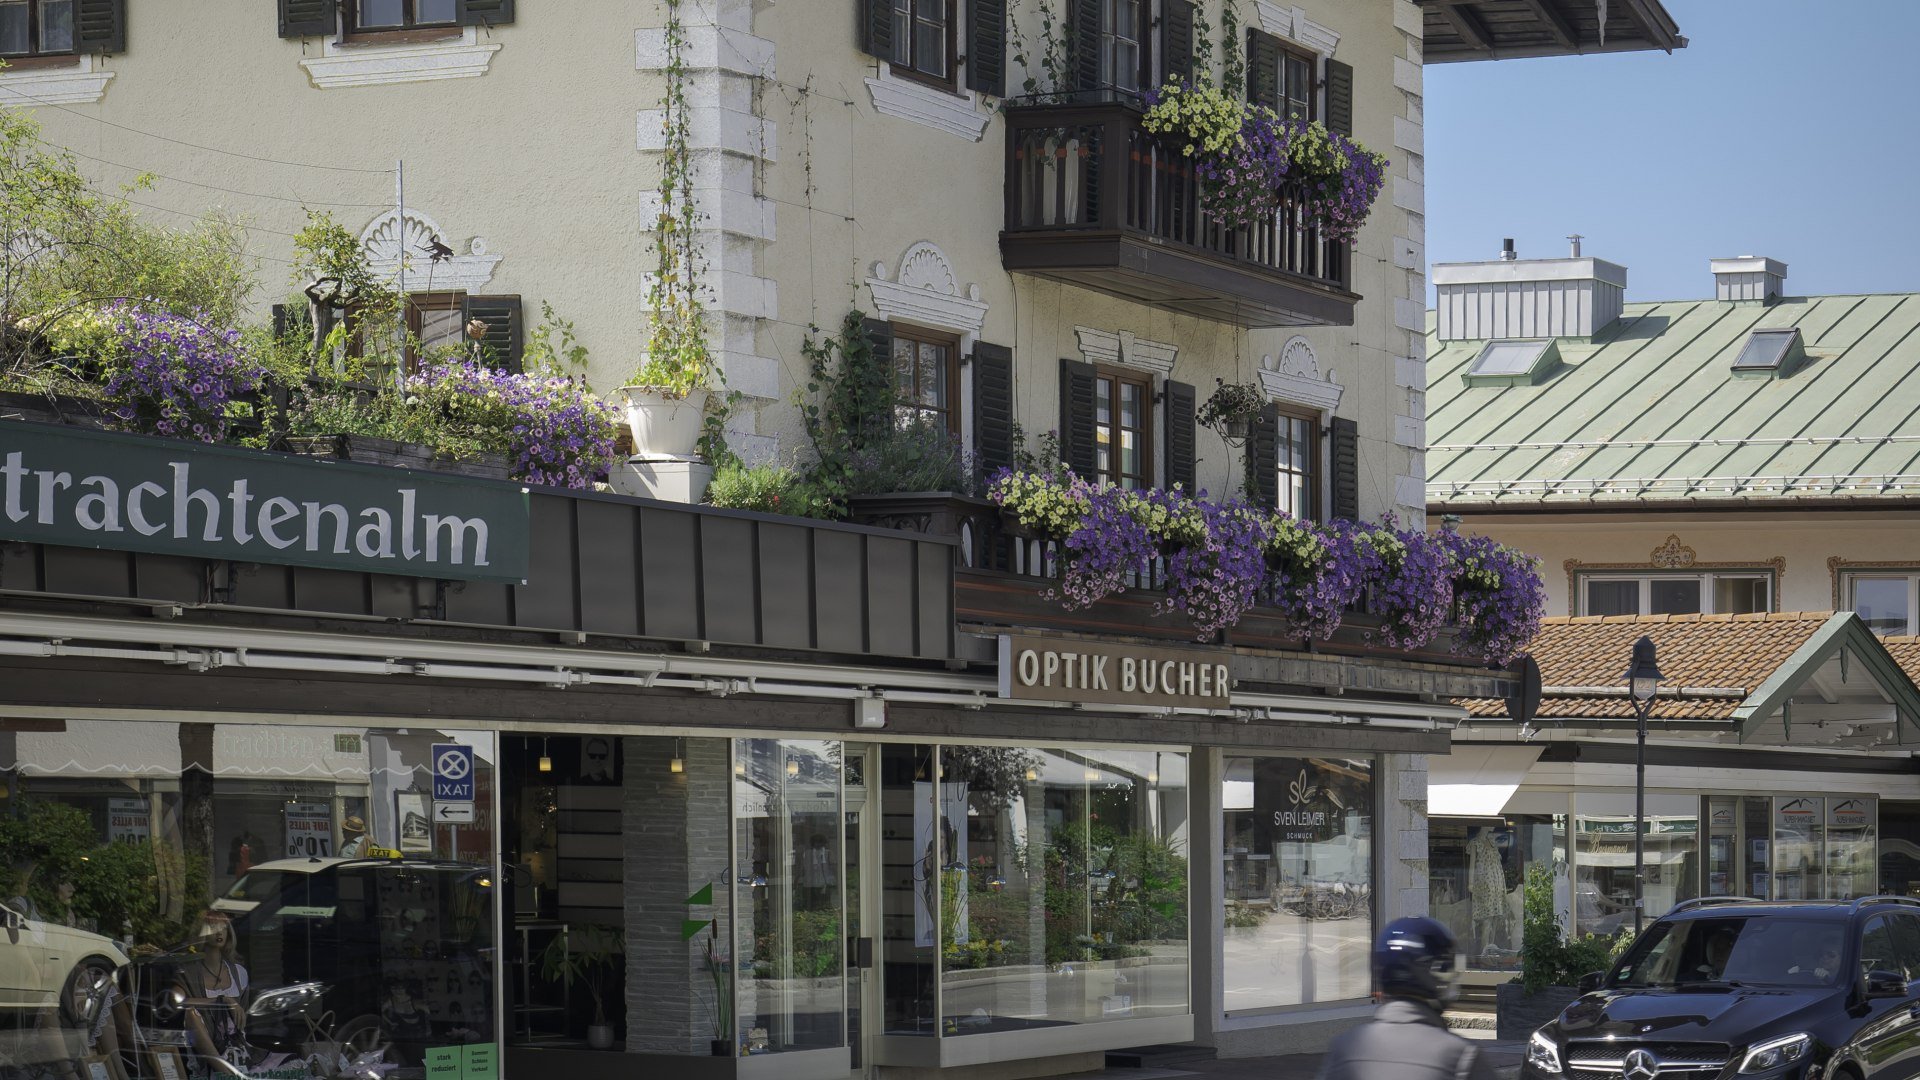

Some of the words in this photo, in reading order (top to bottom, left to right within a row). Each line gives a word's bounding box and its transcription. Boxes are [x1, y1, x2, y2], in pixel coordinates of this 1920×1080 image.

[0, 452, 489, 566] trachtenalm
[1018, 649, 1108, 690] OPTIK
[1120, 657, 1229, 698] BUCHER
[1274, 811, 1297, 826] SVEN
[1298, 811, 1325, 827] LEIMER
[1286, 832, 1313, 840] SCHMUCK
[432, 1065, 456, 1073] reduziert
